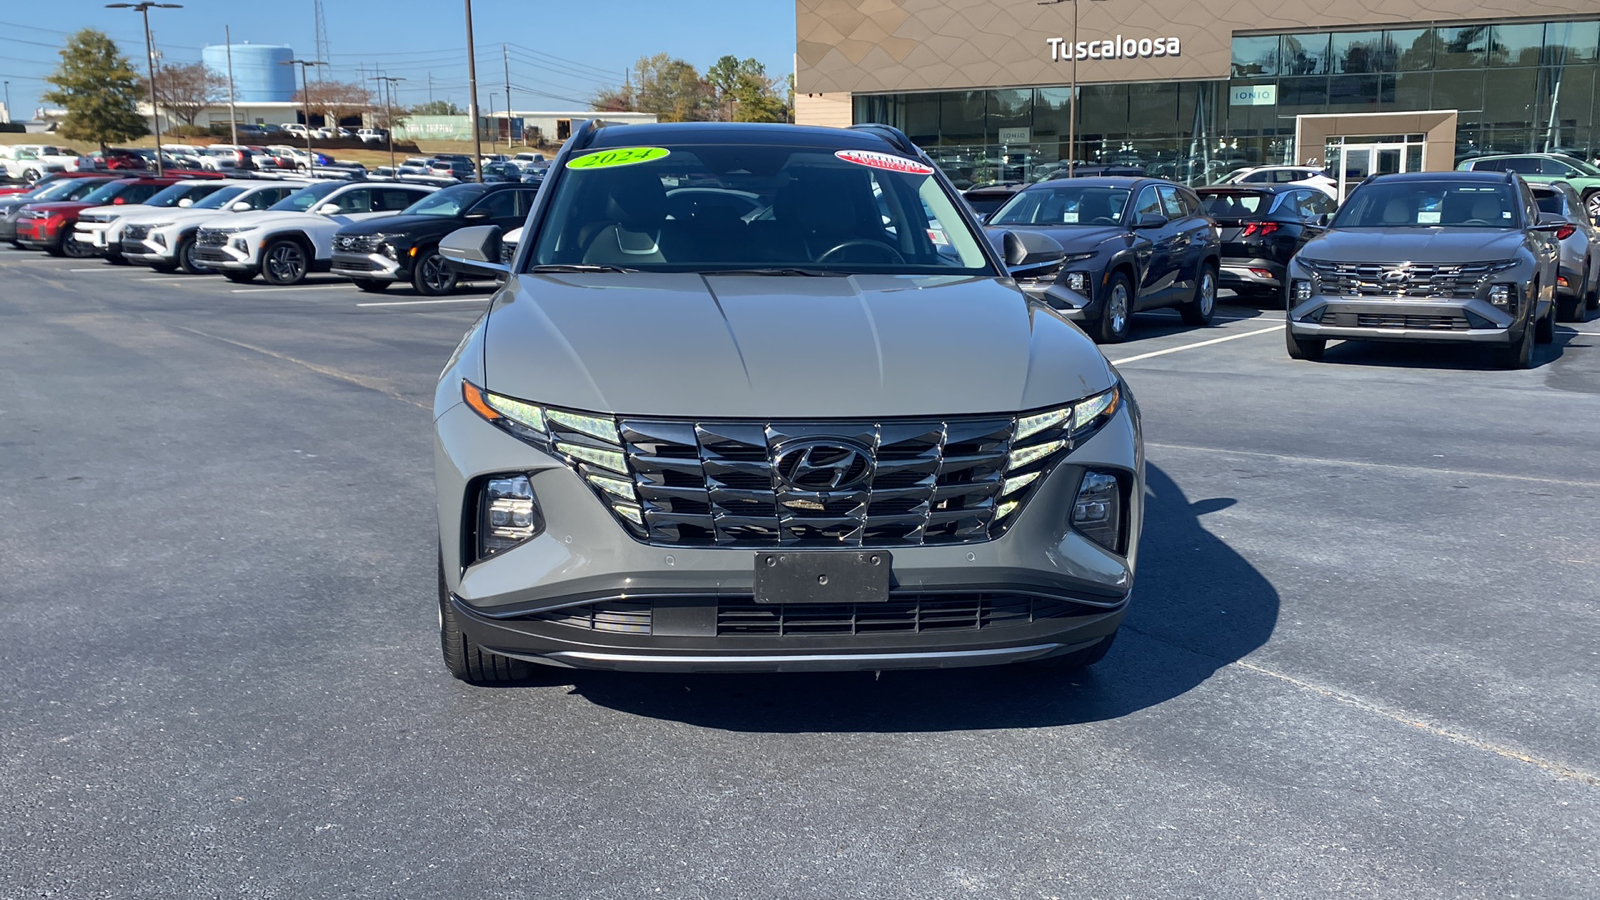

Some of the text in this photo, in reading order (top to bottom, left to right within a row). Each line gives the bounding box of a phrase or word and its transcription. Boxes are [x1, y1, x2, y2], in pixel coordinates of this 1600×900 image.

[1047, 34, 1181, 61] Tuscaloosa
[1235, 91, 1270, 100] IONIQ
[582, 148, 654, 168] 2024
